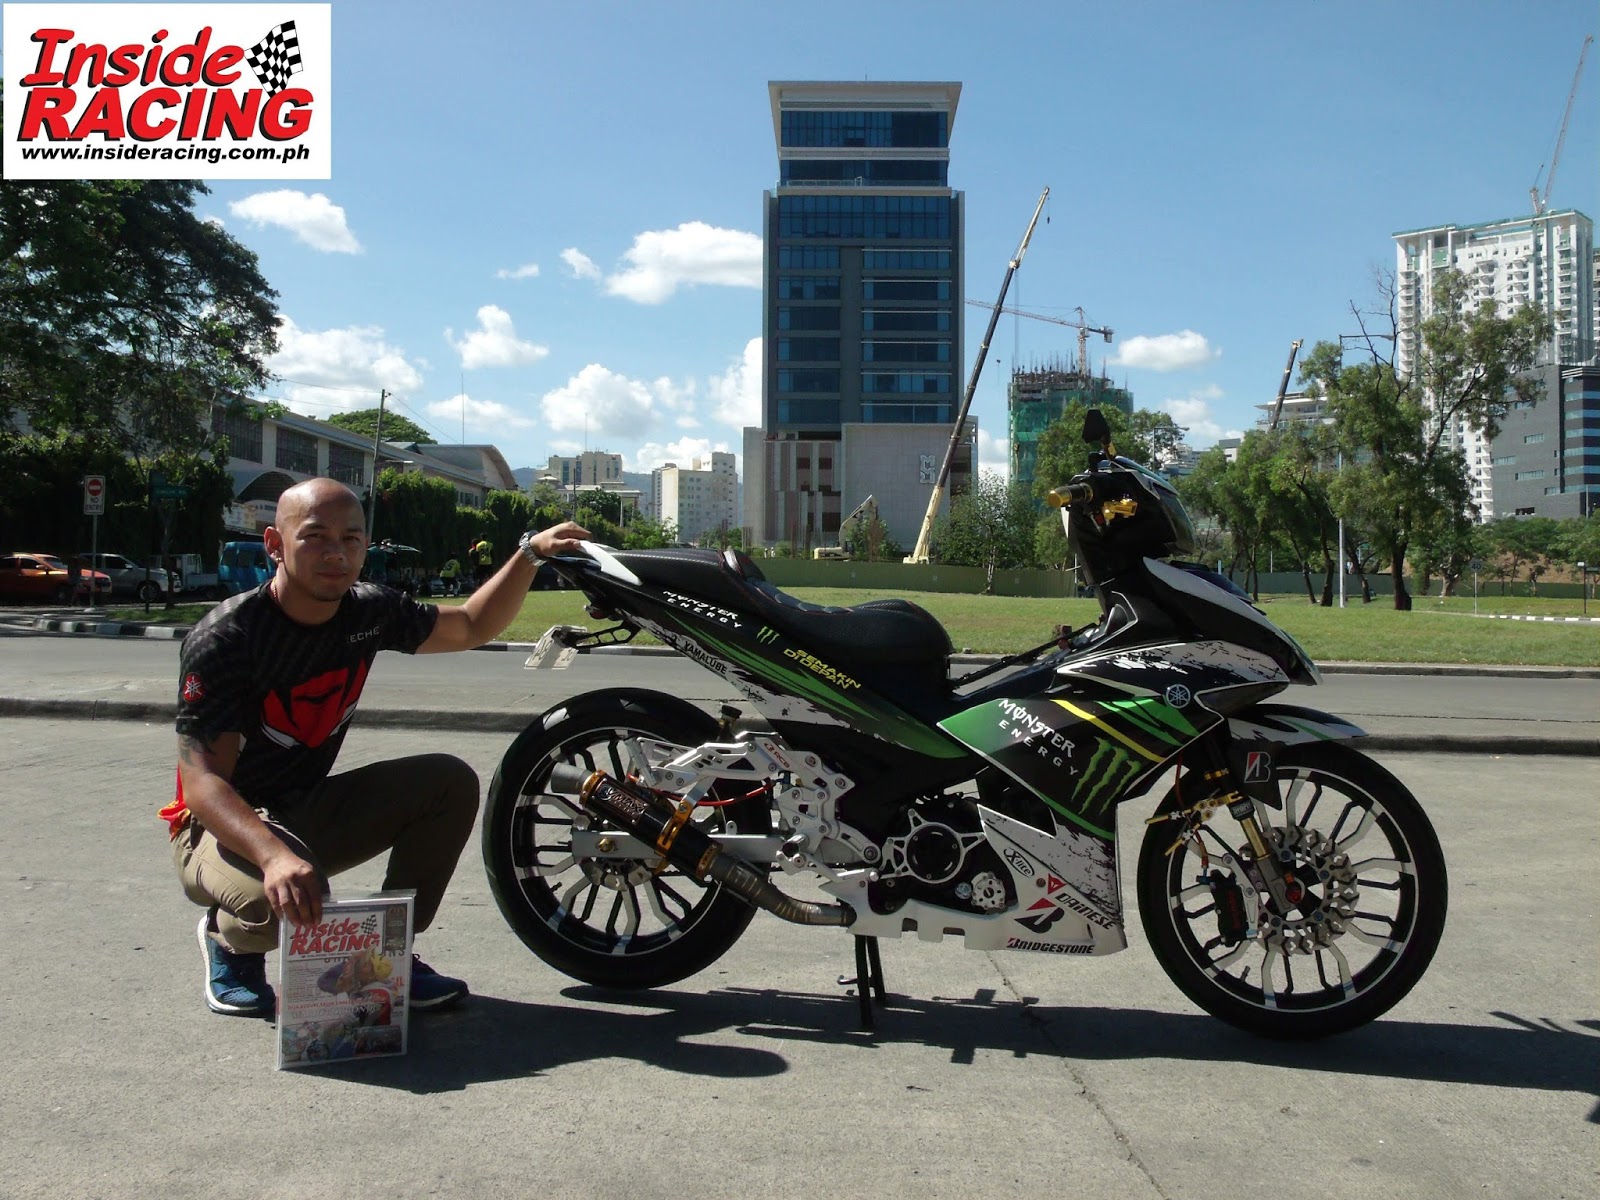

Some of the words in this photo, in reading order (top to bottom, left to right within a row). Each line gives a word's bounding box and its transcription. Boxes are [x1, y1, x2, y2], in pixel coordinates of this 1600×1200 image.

[85, 503, 103, 511] ENTRY
[667, 598, 742, 628] ENERGY
[683, 641, 727, 675] YAMALUBE
[796, 649, 861, 689] SEMAKIN
[998, 699, 1075, 758] MONSTER
[998, 719, 1079, 776] ENERGY
[289, 917, 360, 939] Inside
[289, 932, 380, 956] RACING
[1006, 937, 1095, 954] BRIDGESTONE
